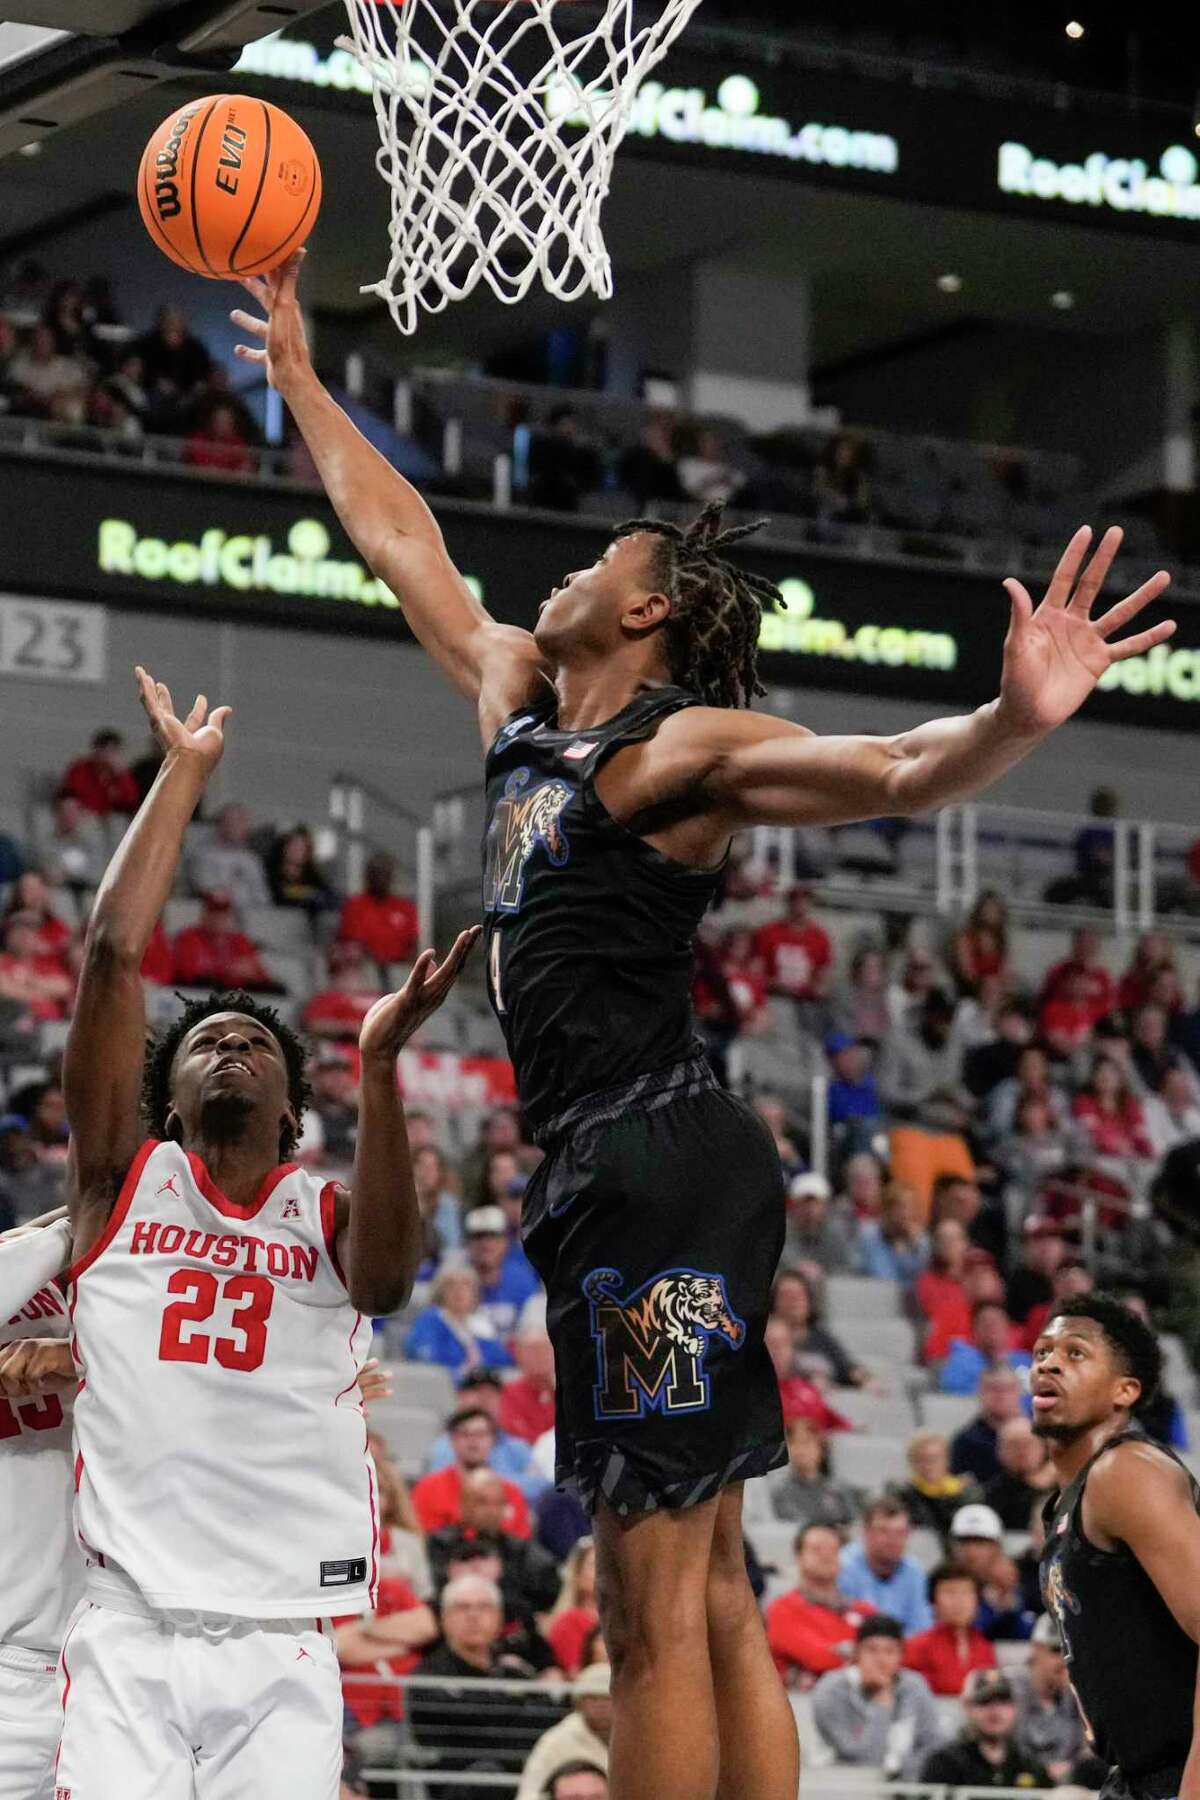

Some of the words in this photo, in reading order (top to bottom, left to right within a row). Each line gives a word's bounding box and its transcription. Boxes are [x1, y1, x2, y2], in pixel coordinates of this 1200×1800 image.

[154, 106, 200, 221] Wilson
[215, 123, 247, 196] EVO
[997, 141, 1200, 220] RoofClai
[98, 518, 481, 608] RoofClaim.
[12, 609, 85, 671] 23
[129, 1222, 319, 1282] HOUSTON
[158, 1268, 275, 1372] 23
